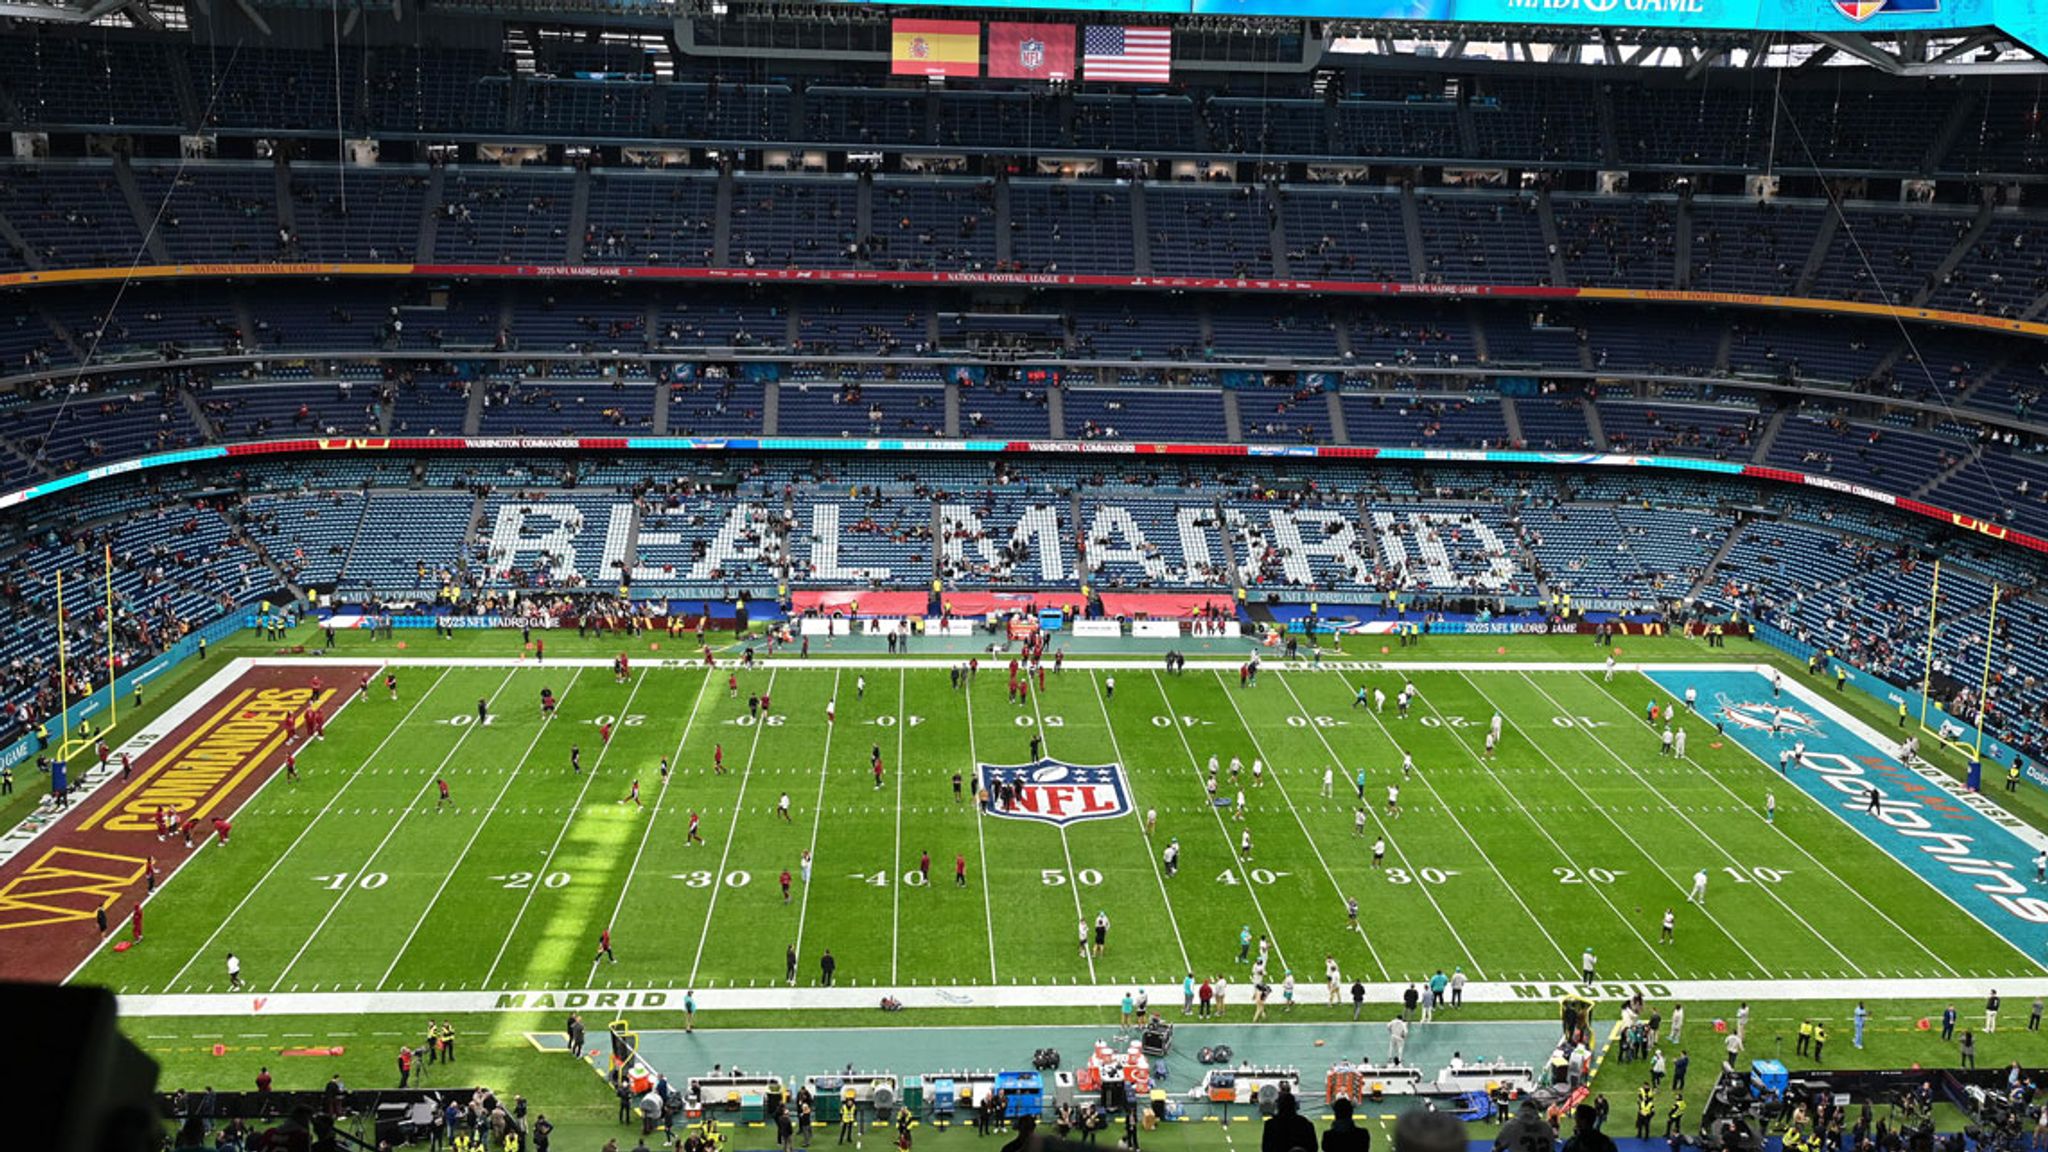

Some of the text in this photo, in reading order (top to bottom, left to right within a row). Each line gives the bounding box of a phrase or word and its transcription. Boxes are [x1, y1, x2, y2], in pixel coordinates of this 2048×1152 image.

[1023, 52, 1043, 65] NFL
[948, 273, 1059, 284] NATIONAL FOOTBALL LEAGUE
[464, 438, 580, 448] WASHINGTON COMMANDERS
[489, 502, 1514, 588] REAL MADRID
[466, 615, 488, 628] NFL
[488, 616, 529, 628] MADRID
[1465, 622, 1489, 633] 2025
[1490, 622, 1508, 633] NFL
[1508, 623, 1548, 635] MADRID
[103, 688, 315, 831] COMMANDERS
[1000, 786, 1115, 816] NFL
[1789, 750, 2048, 924] Dolphins
[322, 872, 389, 891] 10
[500, 872, 572, 889] 20
[685, 870, 752, 889] 30
[864, 869, 926, 888] 40
[1041, 869, 1104, 887] 50
[1216, 868, 1278, 887] 40
[1384, 866, 1448, 886] 30
[1552, 866, 1617, 885] 20
[1722, 865, 1784, 884] 10
[494, 992, 668, 1008] MADRID
[1510, 984, 1673, 998] MADRID
